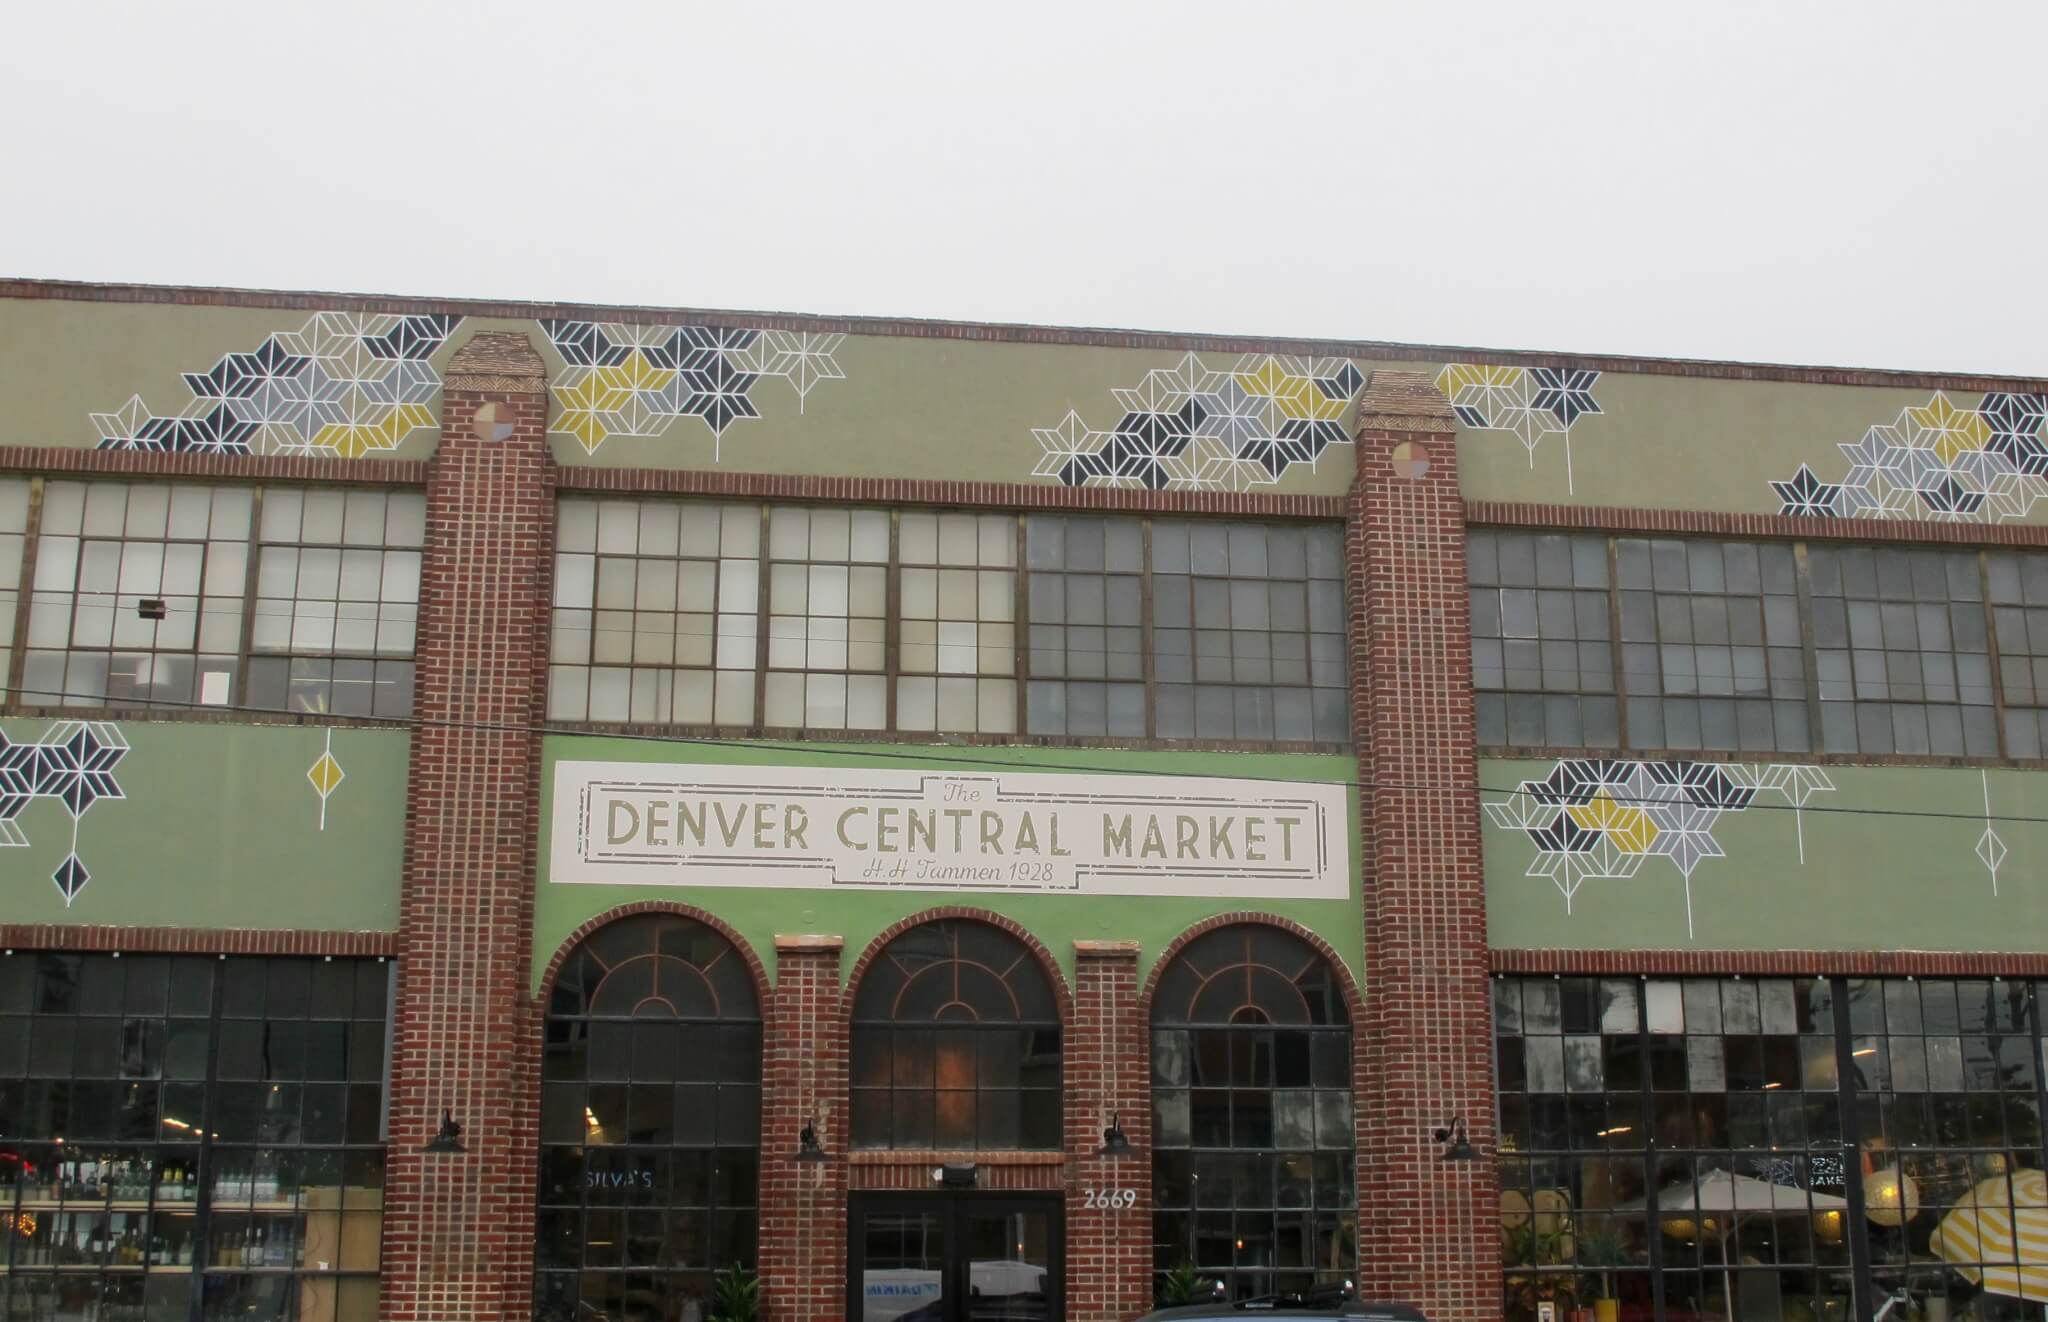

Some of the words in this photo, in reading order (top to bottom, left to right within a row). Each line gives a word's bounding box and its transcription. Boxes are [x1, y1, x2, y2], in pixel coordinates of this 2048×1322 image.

[943, 783, 982, 802] The
[607, 799, 809, 850] DENVER
[836, 806, 1072, 857] CENTRAL
[1102, 813, 1301, 862] MARKET
[916, 859, 1003, 881] Tammen
[1008, 862, 1055, 882] 1928
[586, 1168, 652, 1188] SILVA'S
[1083, 1188, 1137, 1209] 2669
